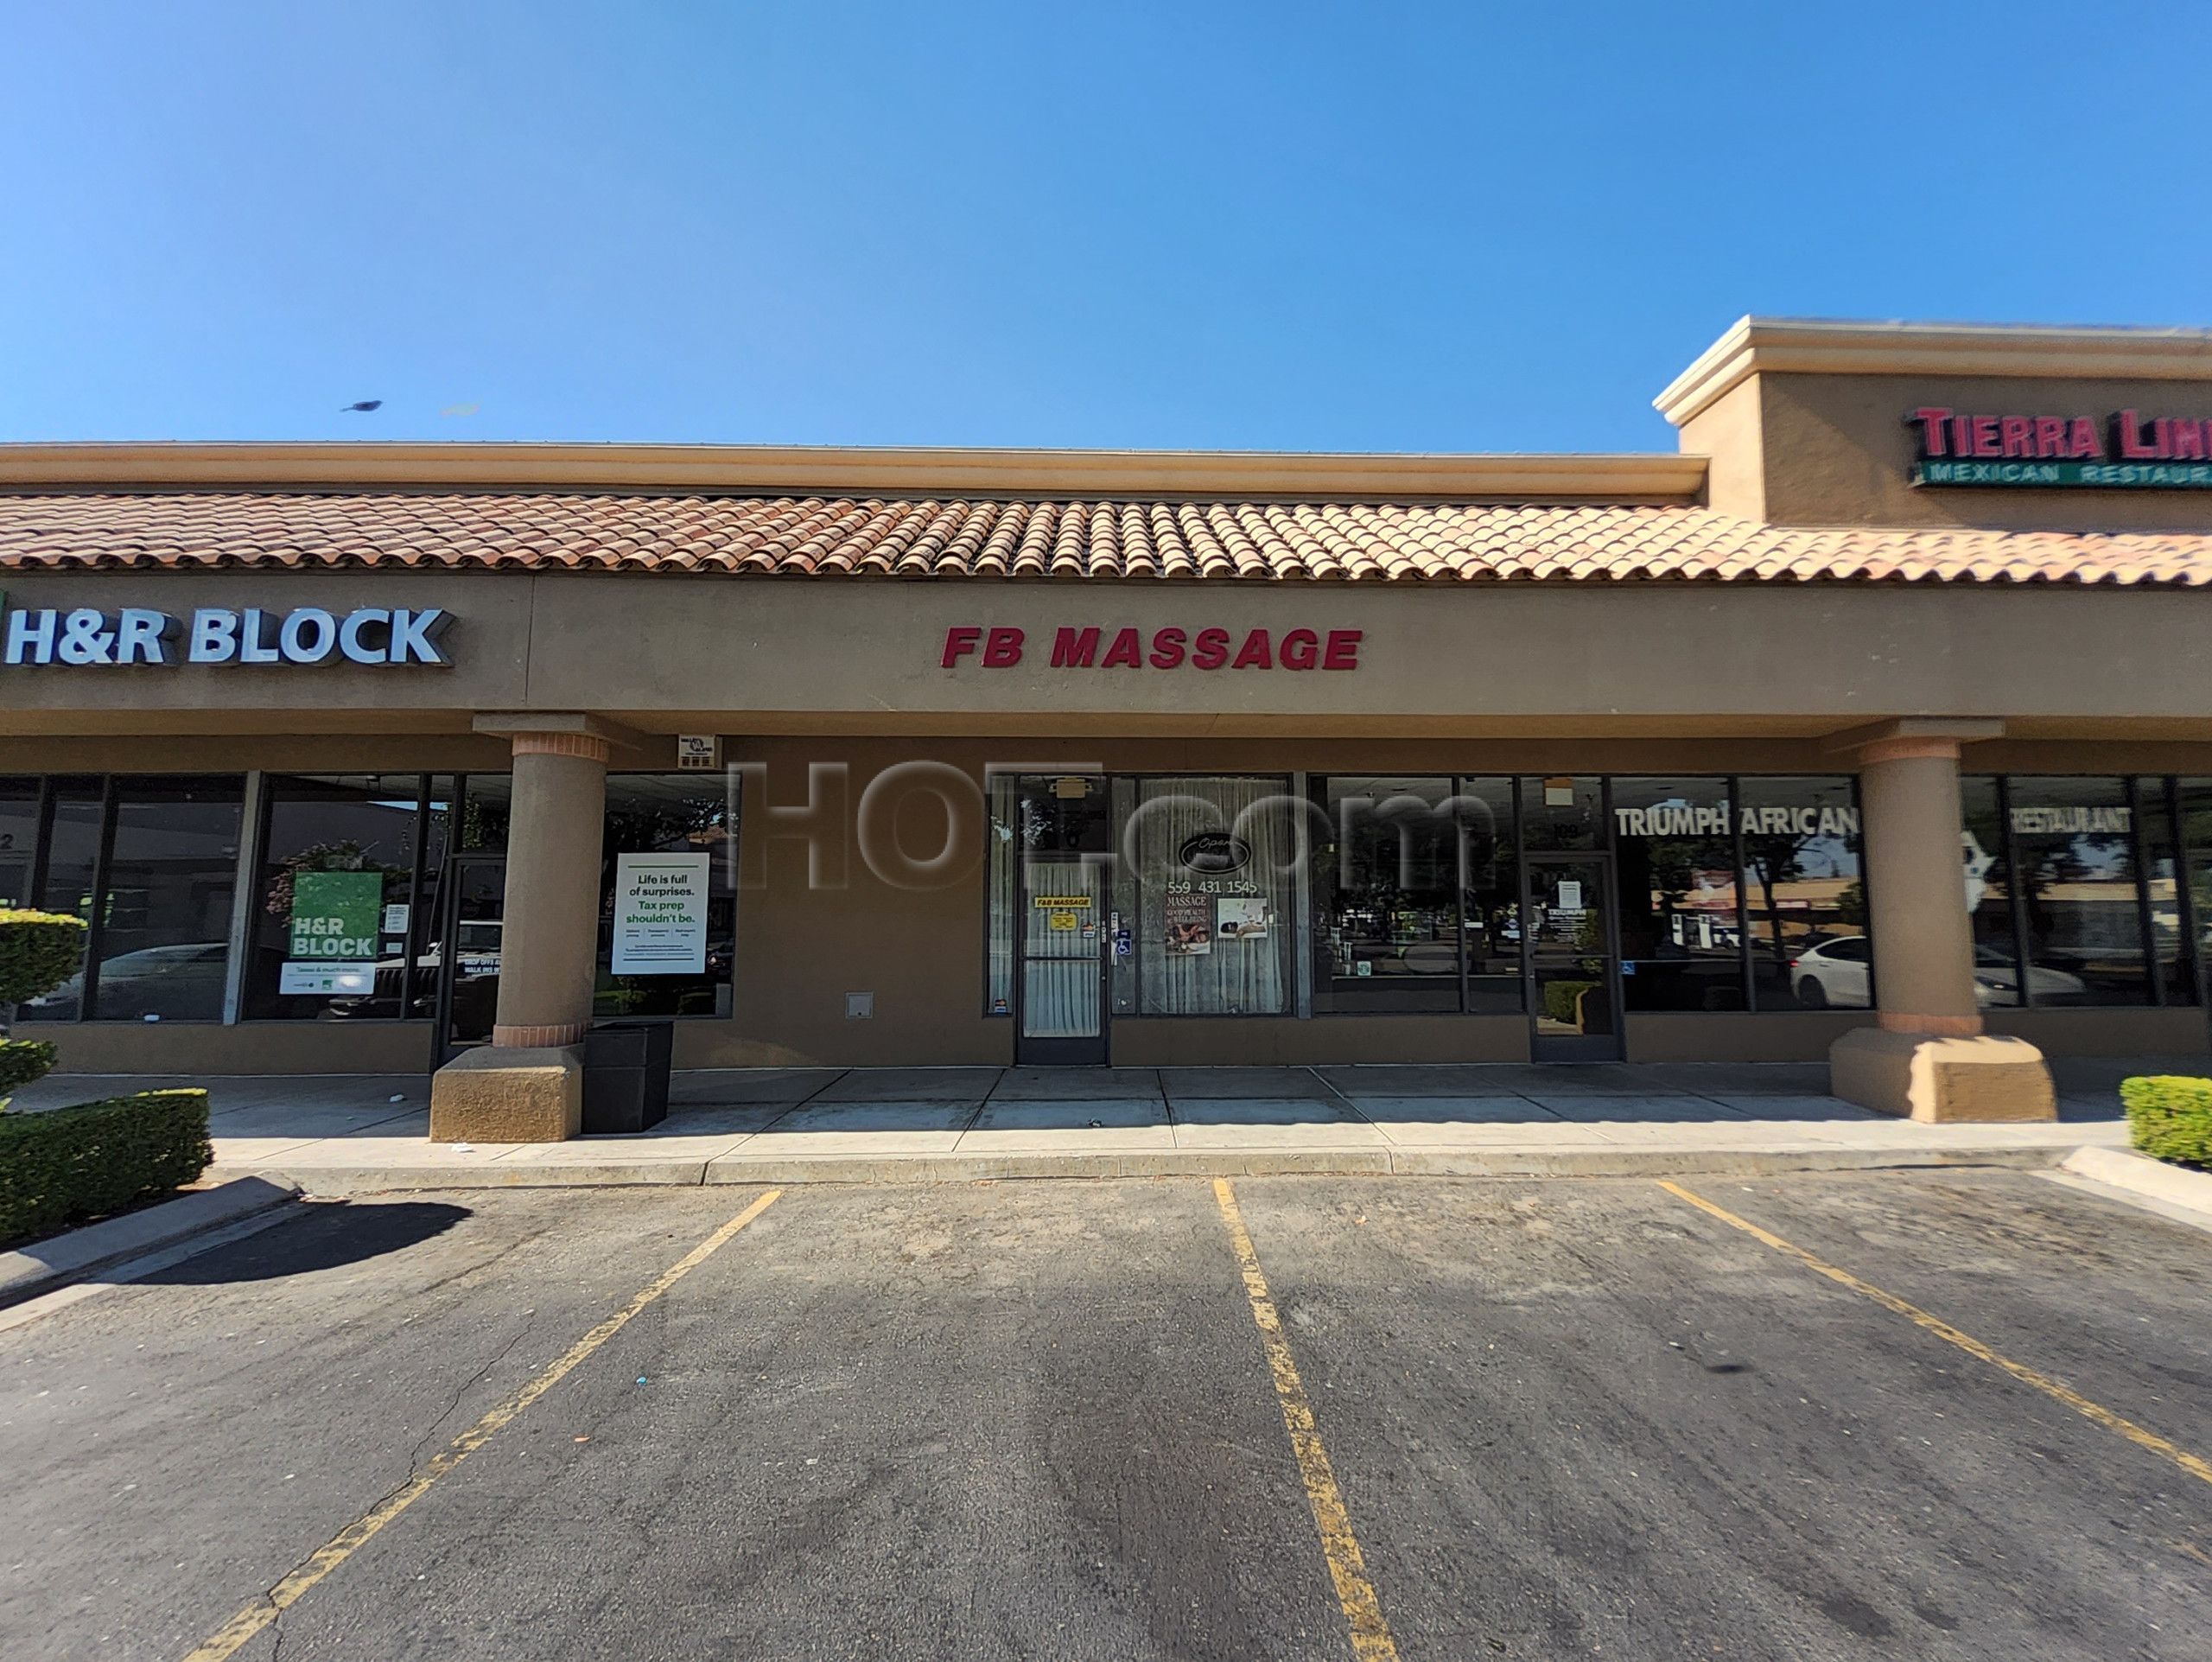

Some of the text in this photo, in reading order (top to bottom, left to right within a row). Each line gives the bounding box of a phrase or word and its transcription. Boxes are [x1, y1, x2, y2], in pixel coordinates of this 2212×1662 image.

[1914, 407, 2103, 458] TIERRA
[1929, 463, 2060, 484] MEXICAN
[3, 608, 446, 664] H&R BLOCK
[941, 627, 1363, 671] FB MASSAGE
[1615, 807, 1859, 837] TRIUMPH AFRICAN
[638, 875, 688, 884] Life is full
[1167, 882, 1258, 895] 559 431 1545
[629, 887, 695, 897] of surprises.
[639, 901, 684, 912] Tax prep
[1166, 896, 1207, 907] MASSAGE
[294, 917, 345, 935] H&R
[678, 914, 696, 923] be.
[292, 938, 373, 956] BLOCK
